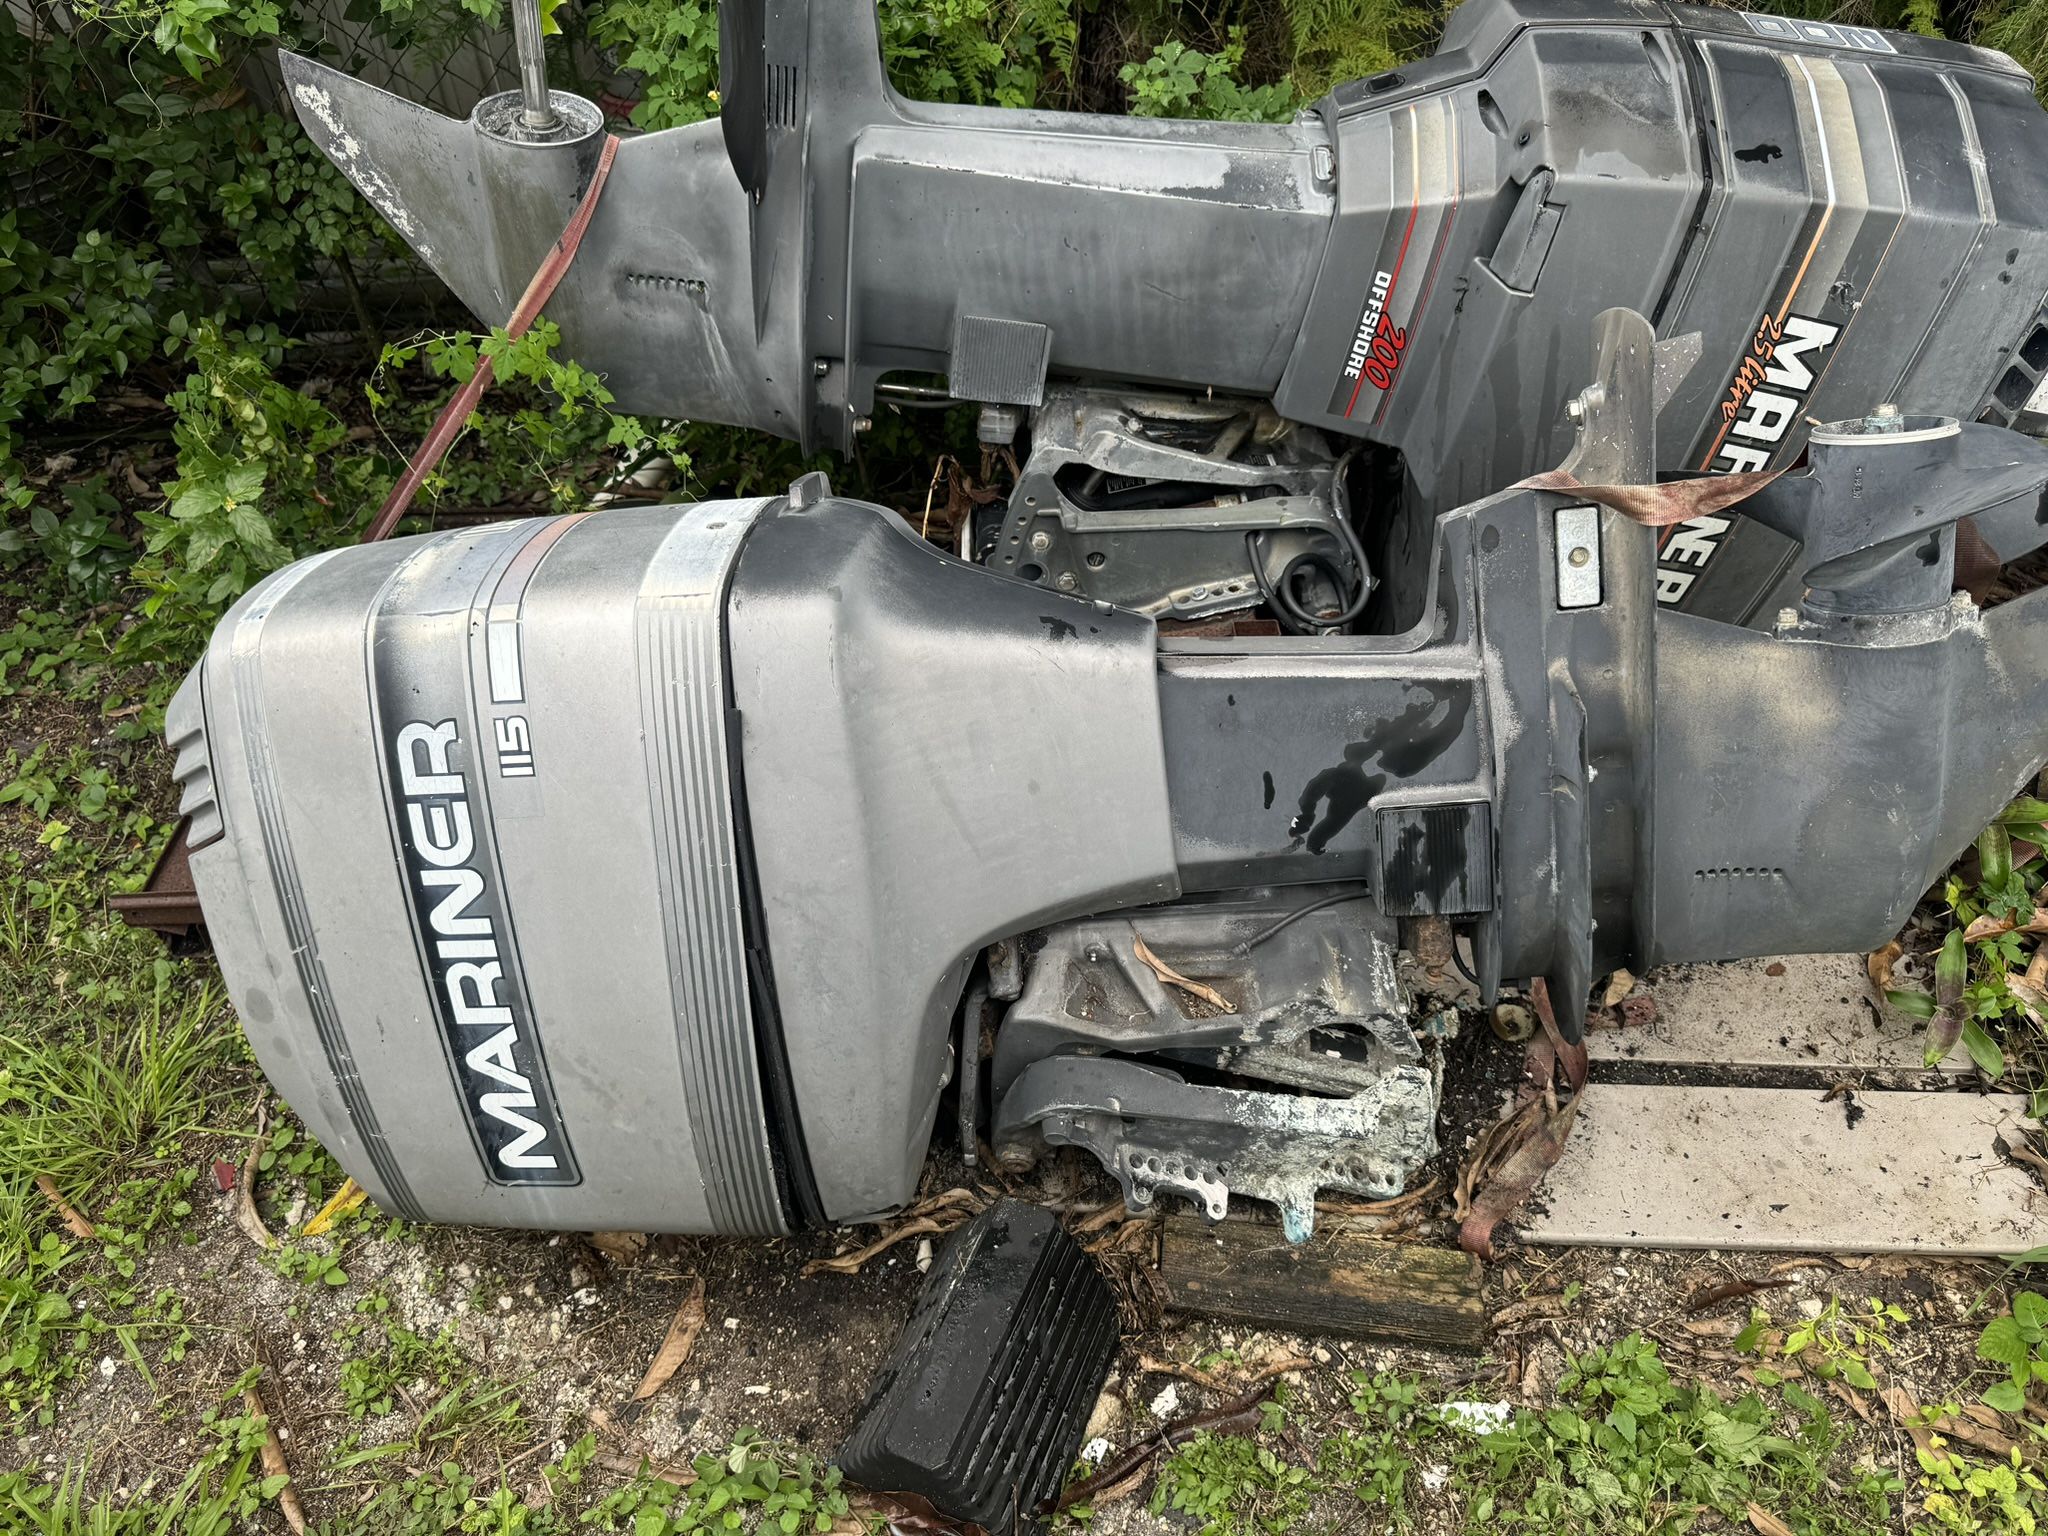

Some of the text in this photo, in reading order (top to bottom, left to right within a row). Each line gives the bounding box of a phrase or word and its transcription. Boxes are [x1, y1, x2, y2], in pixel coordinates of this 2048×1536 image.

[1741, 12, 1897, 54] 200
[1344, 270, 1393, 380] OFFSHORE
[1364, 311, 1407, 391] 200
[1721, 312, 1783, 423] 2.5 litre
[1656, 315, 1840, 604] MARNER
[493, 715, 537, 778] 115
[396, 718, 559, 1170] MARINER
